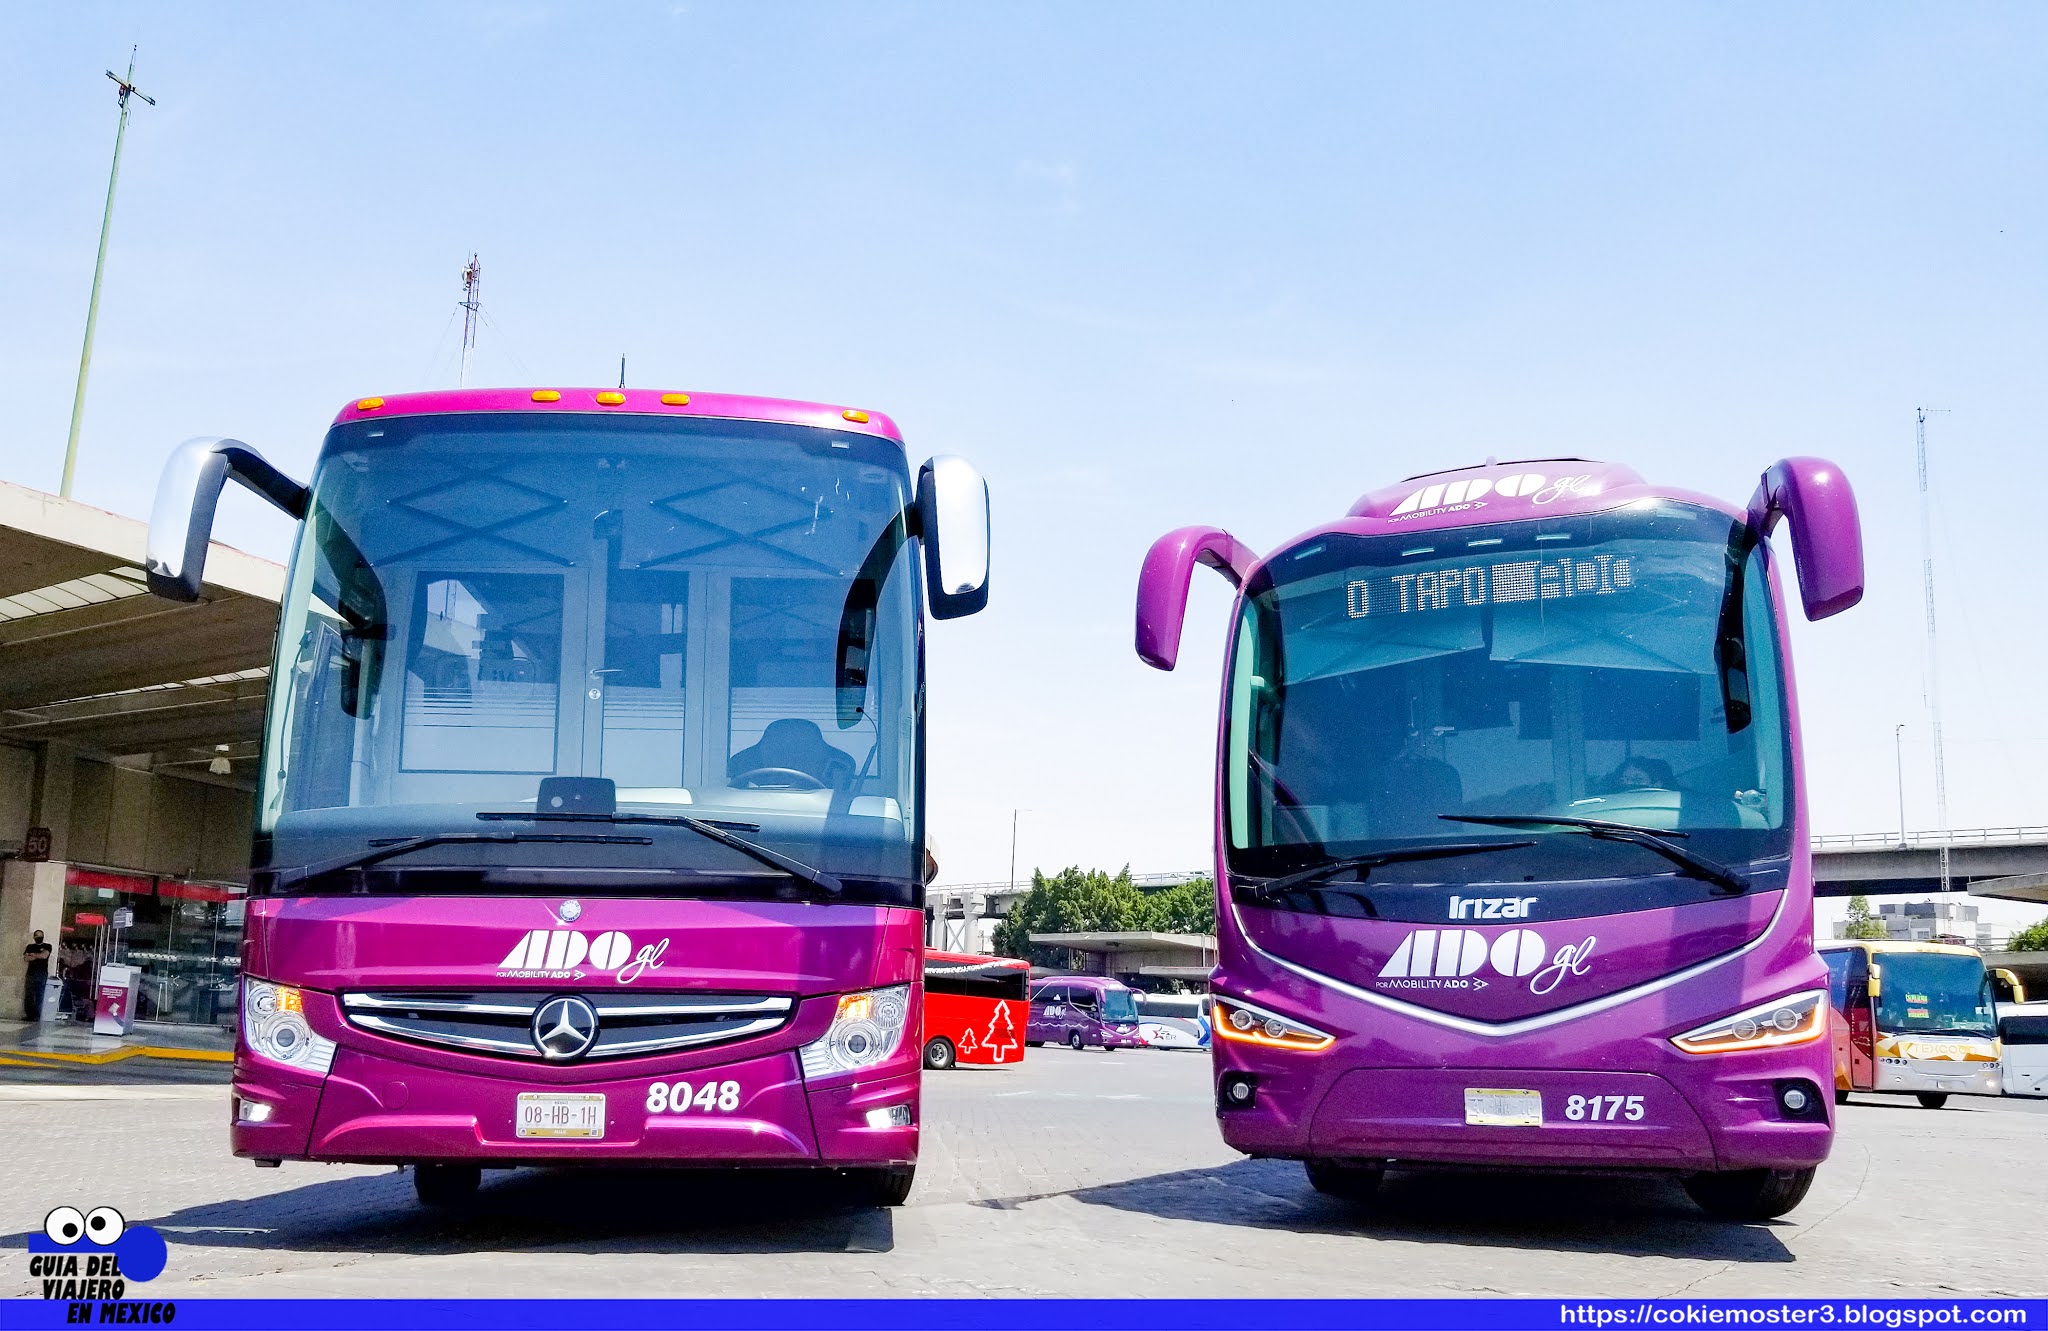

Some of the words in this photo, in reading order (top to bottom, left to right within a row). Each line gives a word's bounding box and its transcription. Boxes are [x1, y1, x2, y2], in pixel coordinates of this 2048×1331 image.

[1400, 507, 1447, 522] MOBILITY
[1448, 503, 1471, 513] ADO
[1391, 566, 1486, 613] TAPO
[1389, 980, 1441, 989] MOBILITY
[1443, 980, 1469, 989] ADO
[646, 1081, 740, 1113] 8048
[1565, 1095, 1645, 1121] 8175
[525, 1105, 597, 1125] 08-HB-1H
